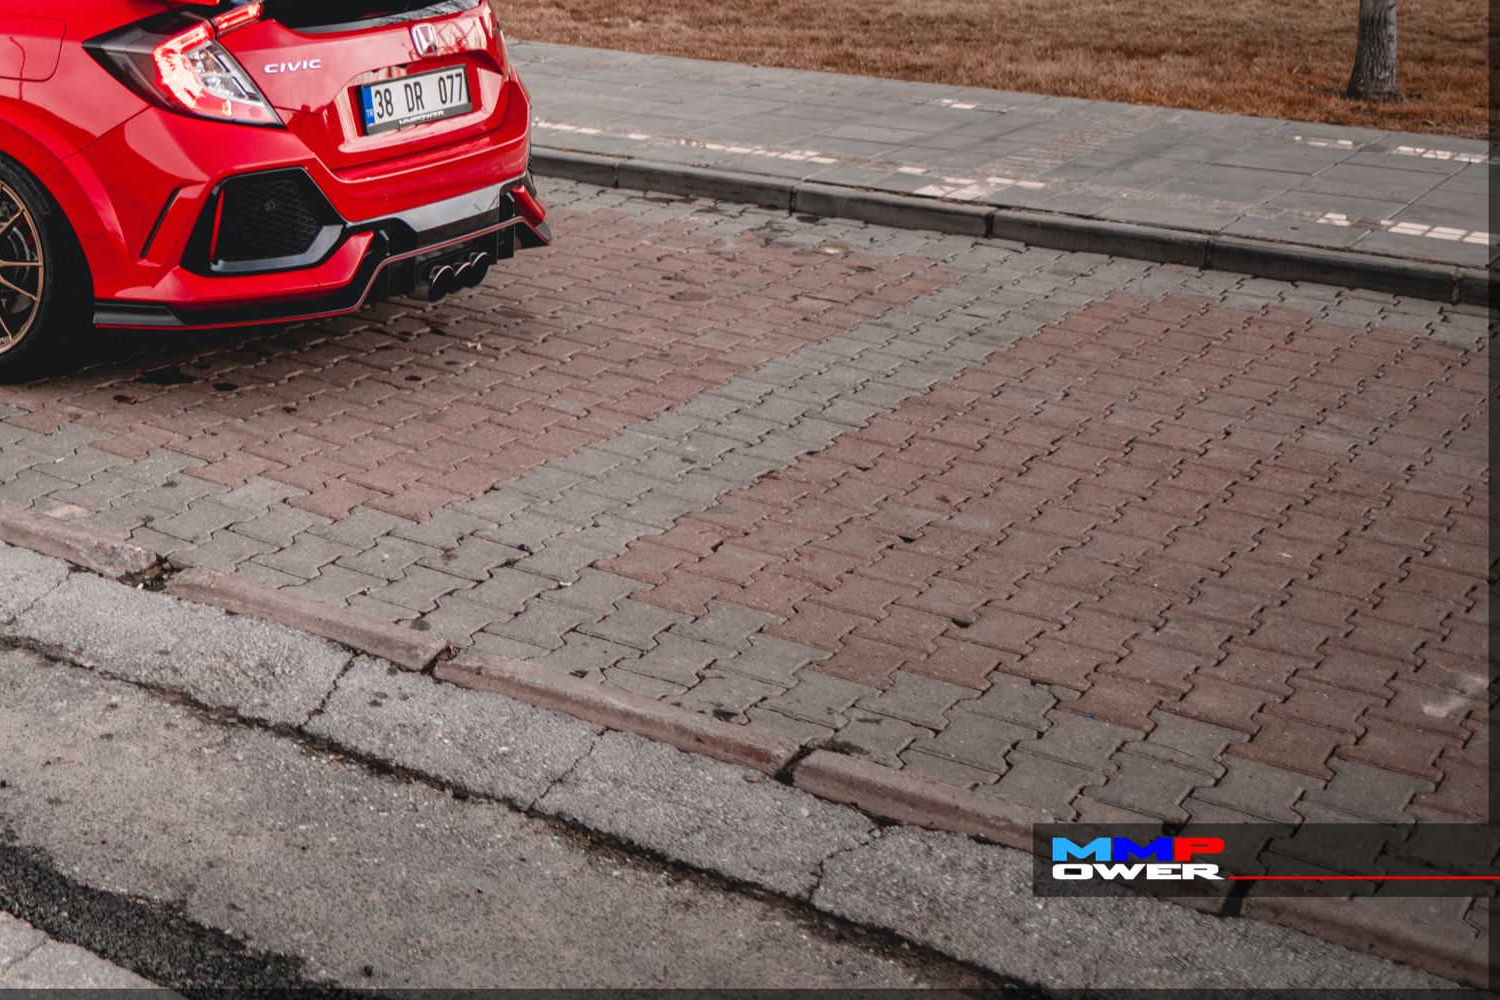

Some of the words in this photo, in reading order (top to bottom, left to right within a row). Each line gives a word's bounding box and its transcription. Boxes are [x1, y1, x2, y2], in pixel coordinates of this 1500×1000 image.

[264, 59, 321, 73] CIVIC
[374, 88, 394, 119] 38
[404, 81, 425, 113] DR
[438, 72, 463, 105] 077
[365, 109, 374, 118] TR
